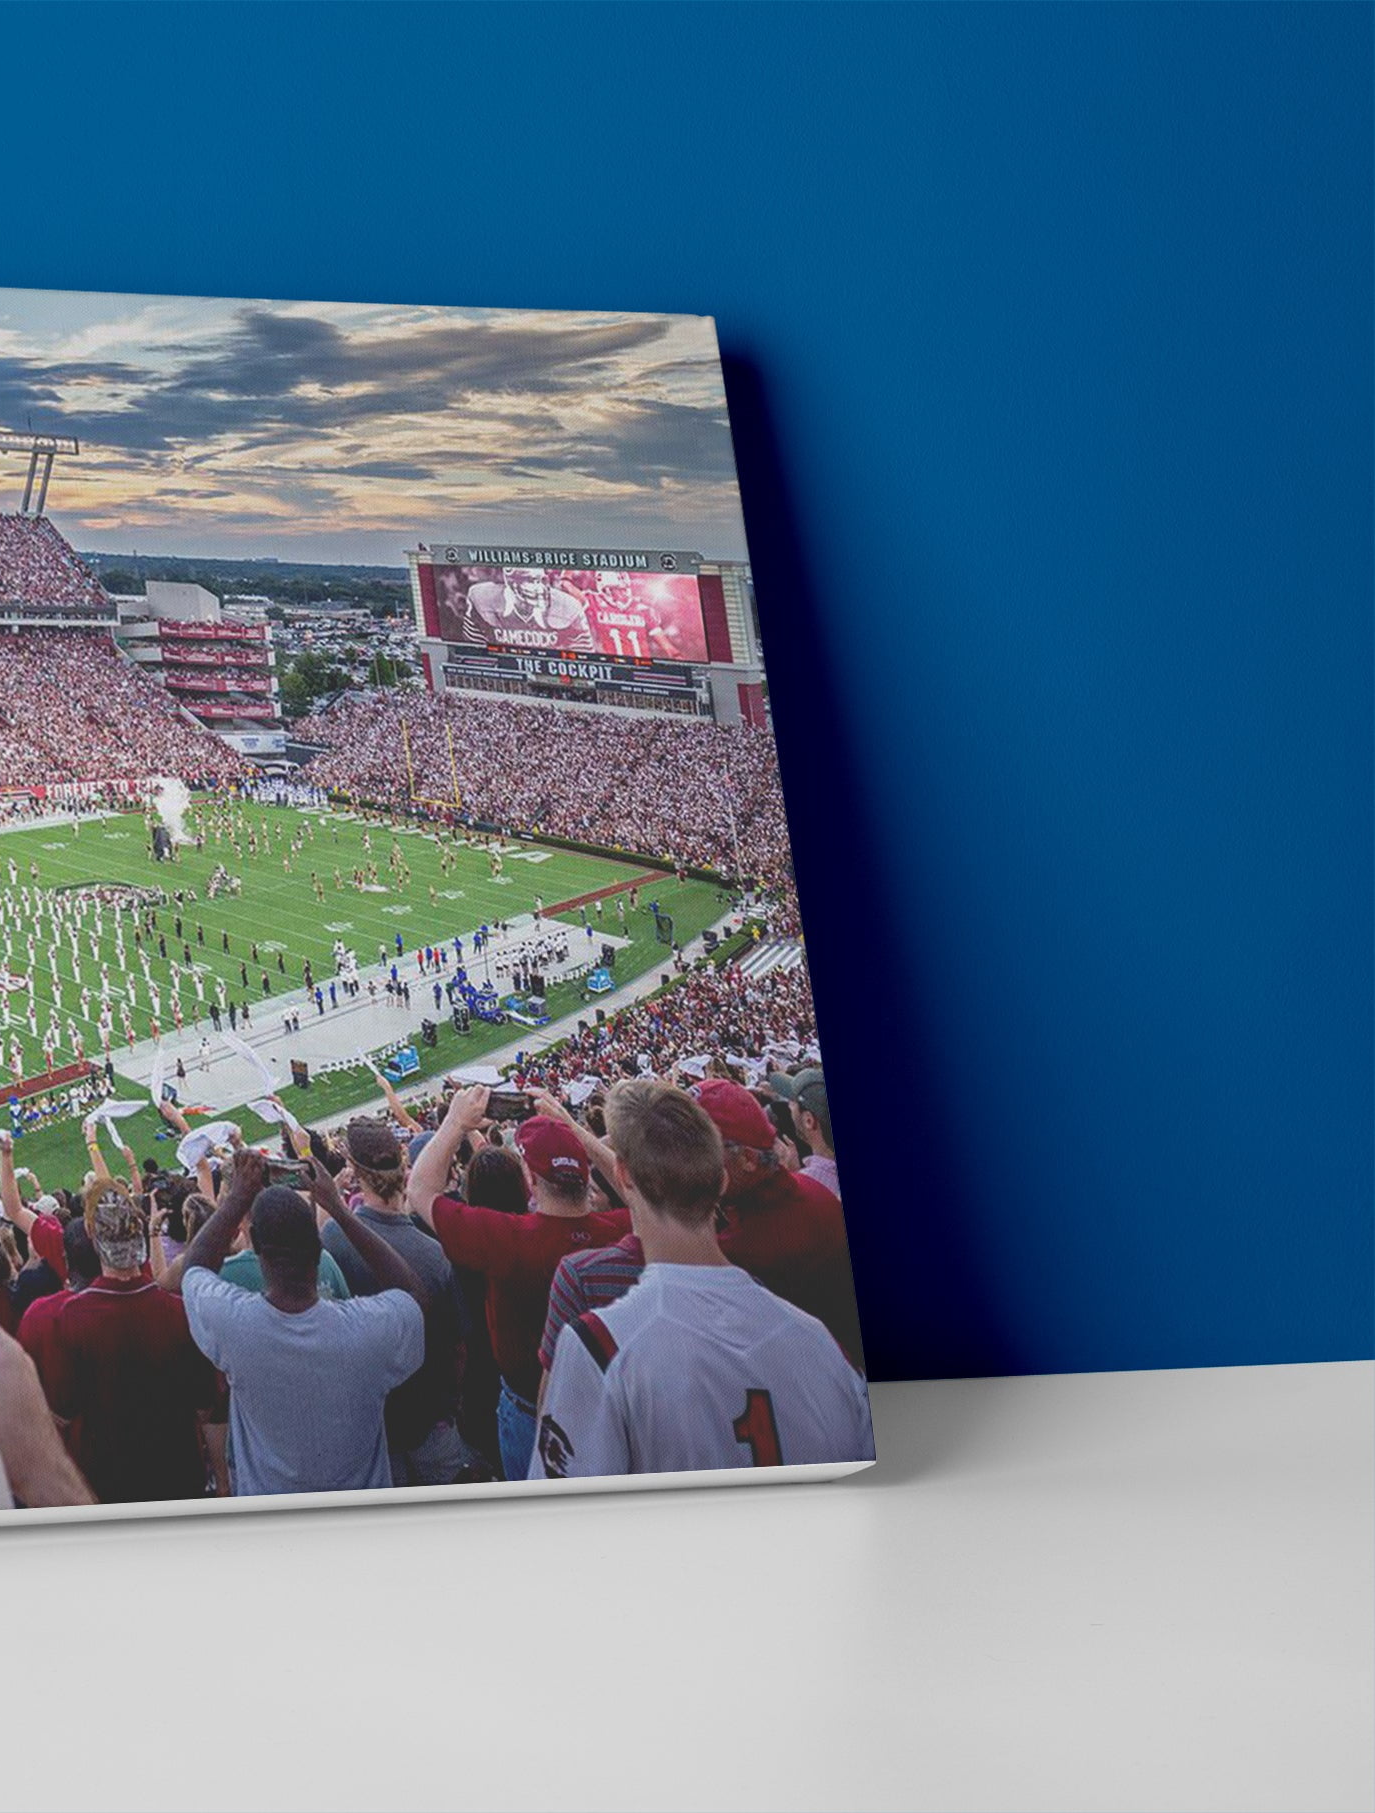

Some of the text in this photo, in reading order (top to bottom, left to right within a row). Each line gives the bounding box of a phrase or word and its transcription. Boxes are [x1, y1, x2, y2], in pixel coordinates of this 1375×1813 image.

[582, 552, 648, 568] STADIUM
[516, 657, 543, 675] THE
[547, 661, 612, 680] COCKPIT
[732, 1388, 783, 1467] 1
